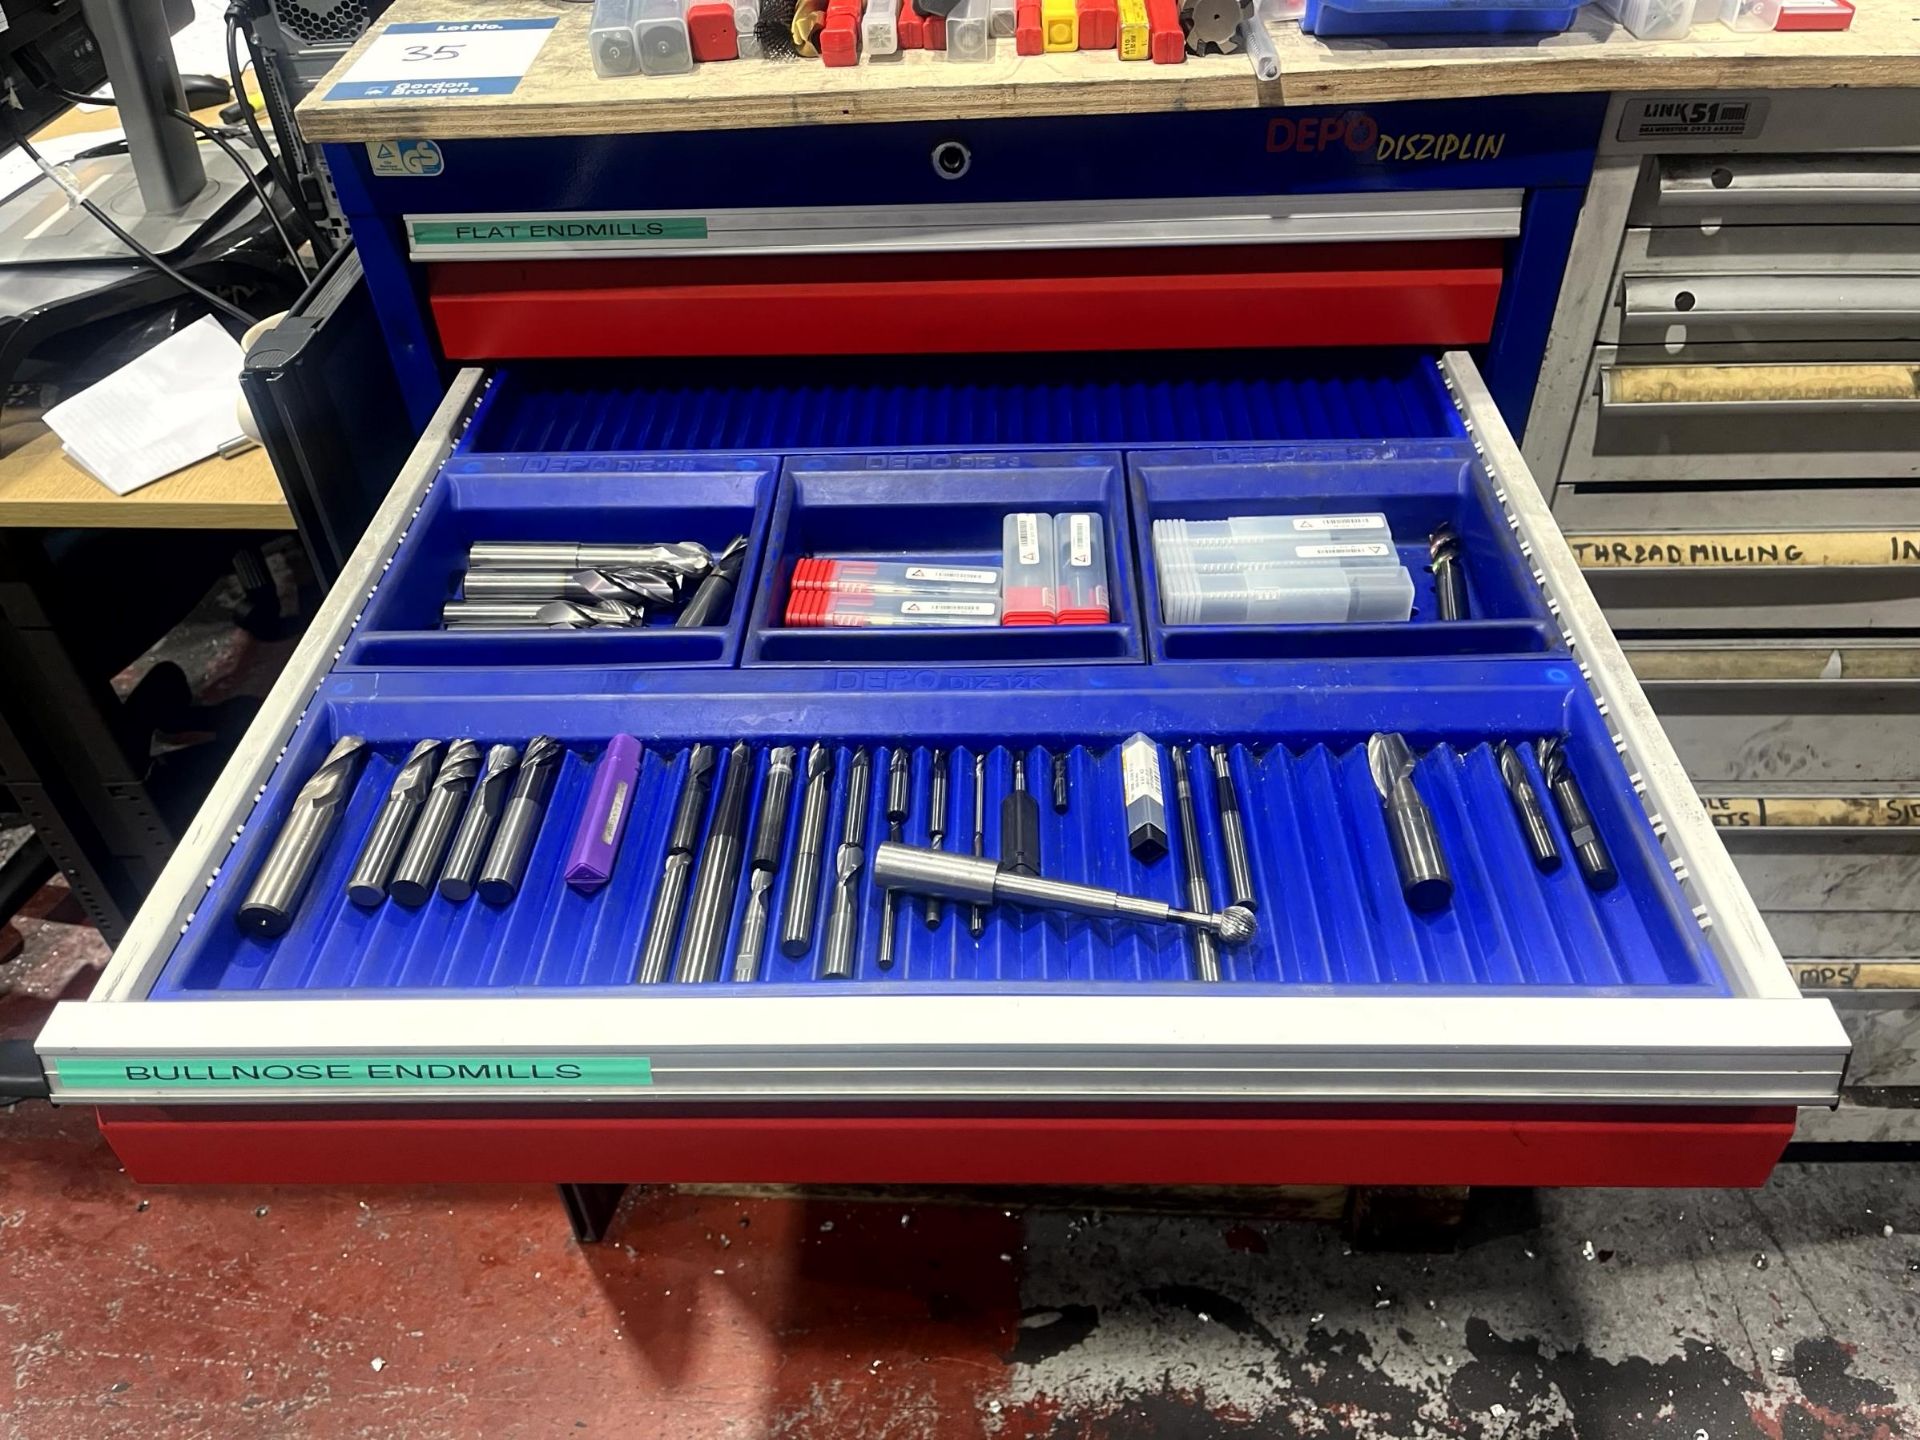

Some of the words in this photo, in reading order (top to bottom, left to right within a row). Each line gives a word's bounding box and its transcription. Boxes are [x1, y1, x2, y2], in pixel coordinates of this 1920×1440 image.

[436, 24, 470, 32] Lot
[472, 23, 504, 31] No.
[401, 44, 467, 61] 35
[391, 86, 479, 96] Brothers
[393, 81, 470, 90] Gordon
[1266, 116, 1379, 152] DEPO
[1376, 133, 1506, 161] DISZIPLIN
[456, 225, 521, 239] FLAT
[529, 222, 664, 238] ENDMILLS
[1690, 543, 1803, 563] MILLING
[835, 669, 939, 691] DEPO
[125, 1064, 353, 1081] BULLNOSE
[367, 1063, 583, 1080] ENDMILLS
